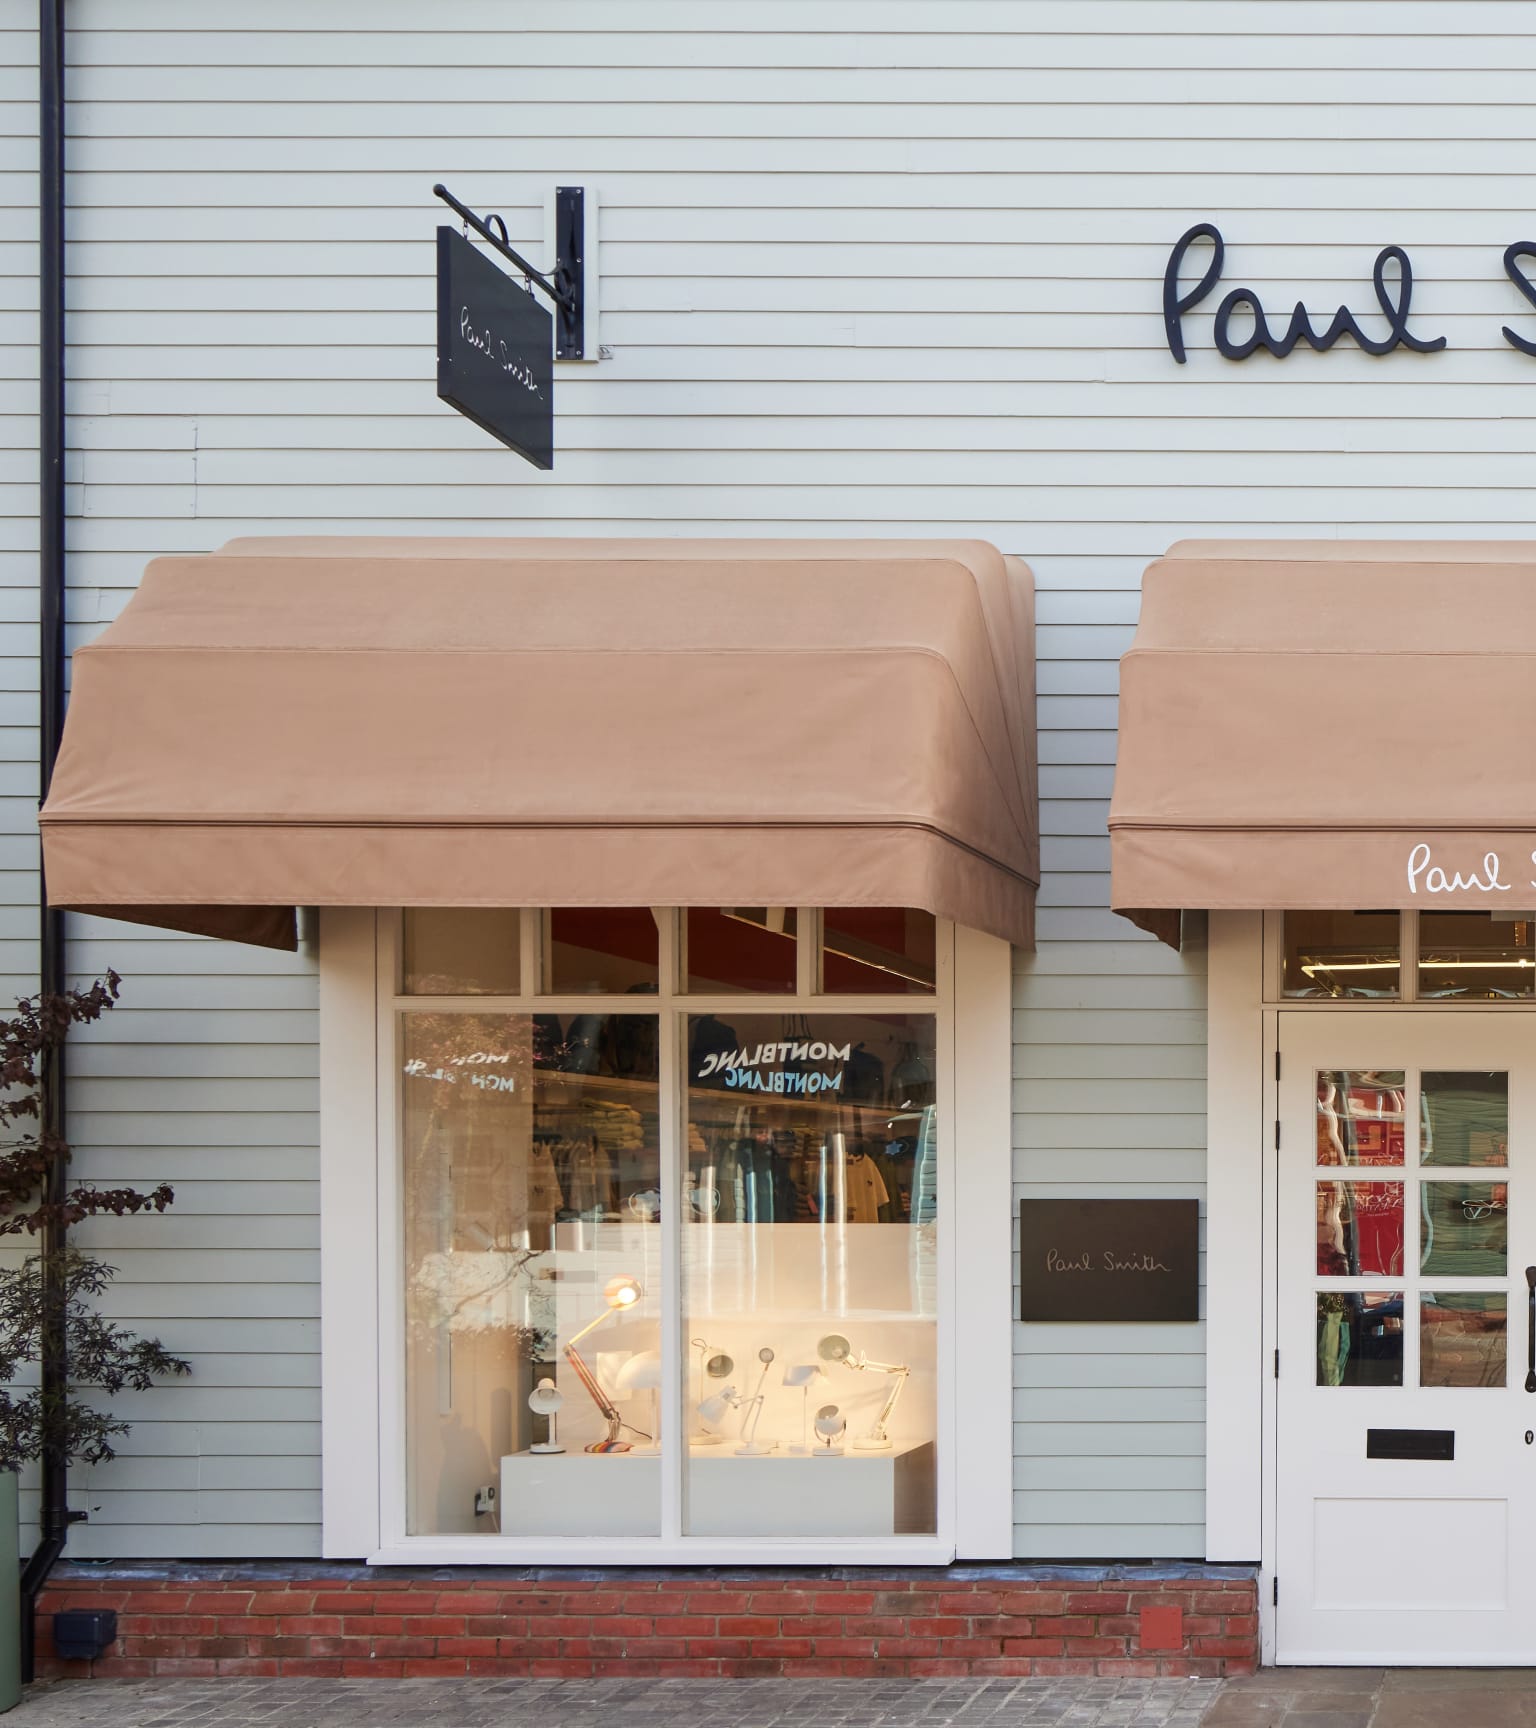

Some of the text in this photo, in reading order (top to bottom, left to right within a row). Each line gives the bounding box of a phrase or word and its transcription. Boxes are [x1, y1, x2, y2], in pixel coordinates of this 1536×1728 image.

[1163, 222, 1447, 364] Paul
[460, 305, 544, 400] Paul Smith
[1407, 843, 1512, 894] Paul
[1047, 1248, 1173, 1272] Paul Smith
